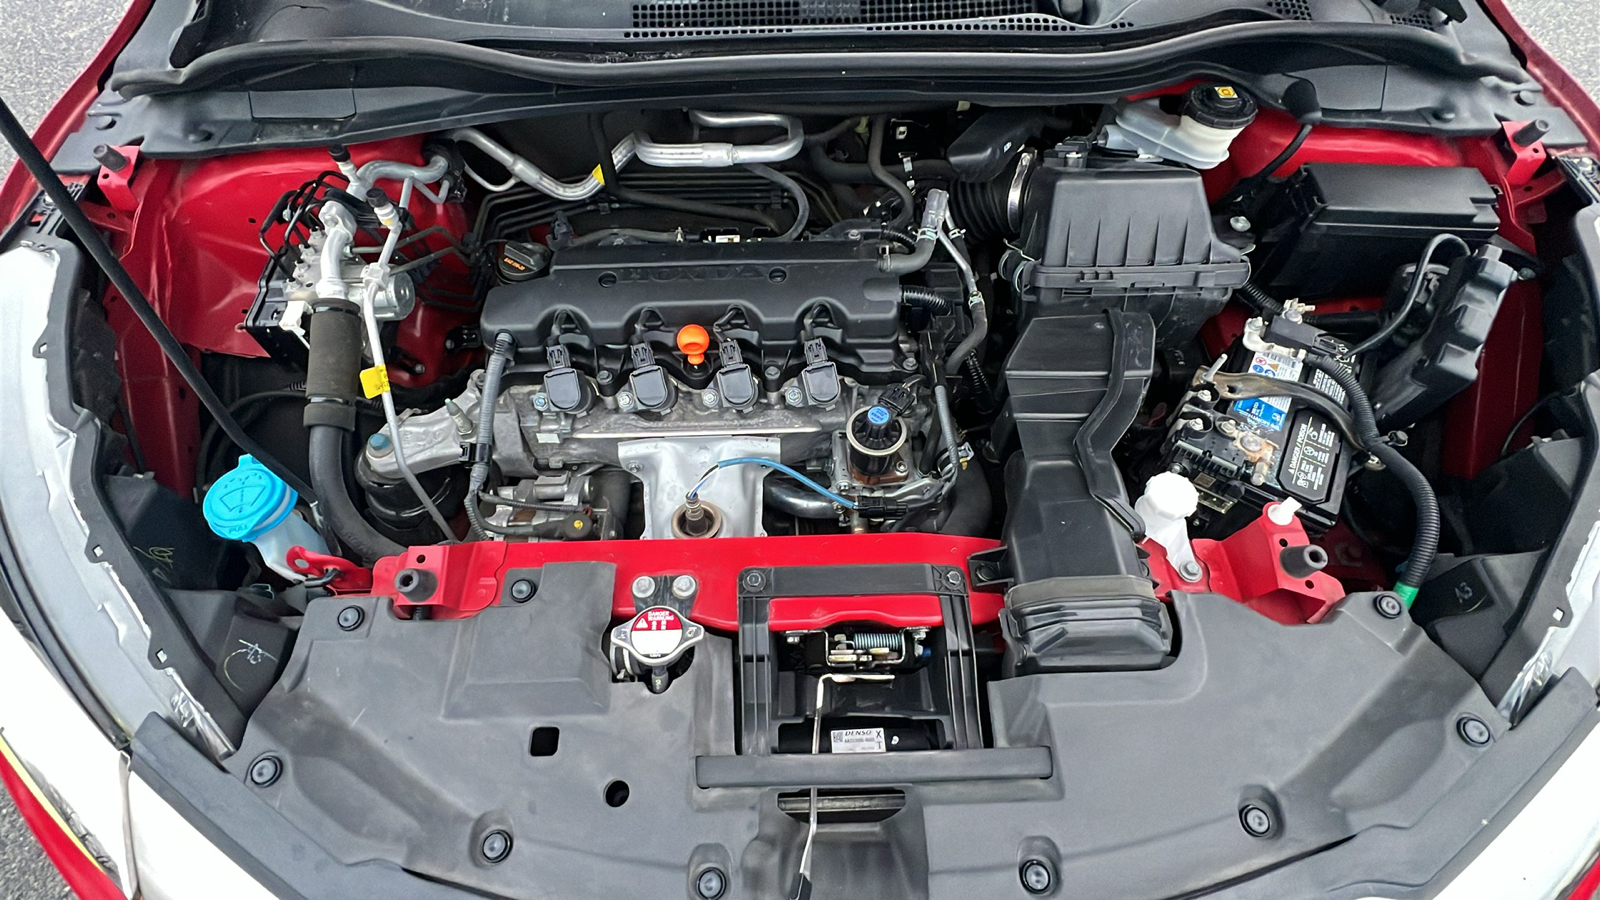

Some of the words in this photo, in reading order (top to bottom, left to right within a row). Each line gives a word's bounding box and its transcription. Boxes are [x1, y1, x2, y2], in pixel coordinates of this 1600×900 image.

[618, 264, 768, 283] HONDA
[1290, 446, 1300, 469] DANGER
[1296, 423, 1308, 444] POISON
